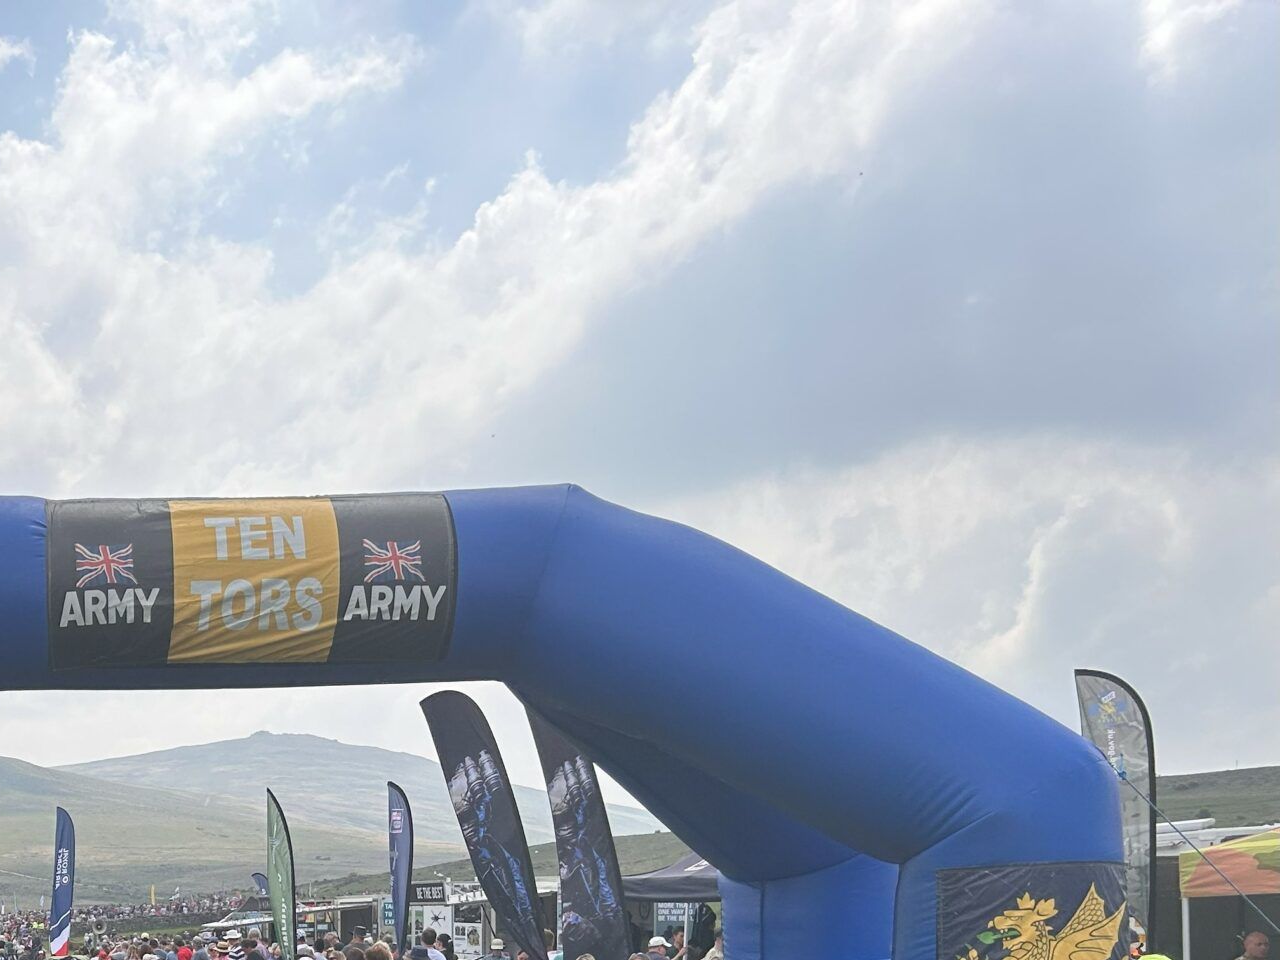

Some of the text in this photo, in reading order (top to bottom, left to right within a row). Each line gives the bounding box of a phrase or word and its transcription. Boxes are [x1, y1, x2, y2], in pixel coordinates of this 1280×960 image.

[204, 515, 306, 561] TEN
[59, 587, 160, 628] ARMY
[190, 577, 323, 632] TORS
[343, 584, 447, 621] ARMY
